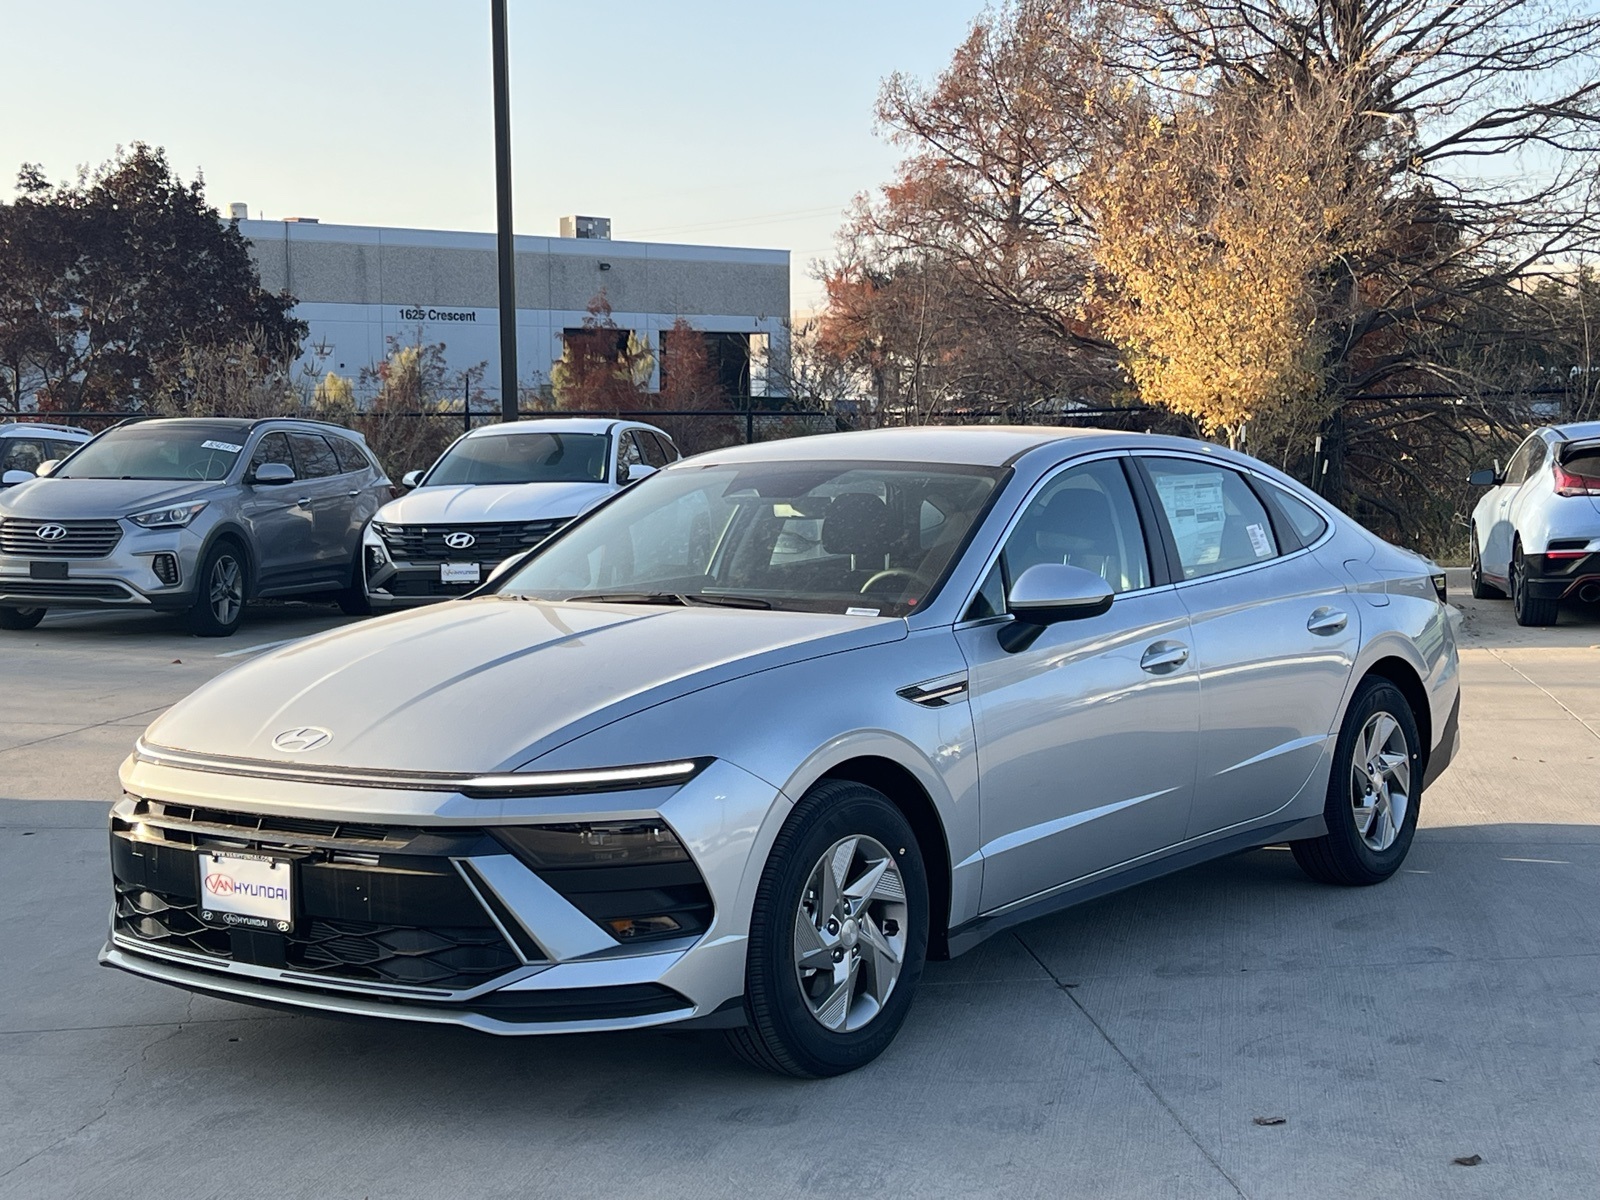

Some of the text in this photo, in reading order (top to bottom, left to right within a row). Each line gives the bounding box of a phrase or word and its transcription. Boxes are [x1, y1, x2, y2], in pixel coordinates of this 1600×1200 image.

[399, 309, 476, 322] 1625 Crescent
[207, 874, 288, 900] VAN HYUNDAI
[238, 917, 268, 927] HYUNDAI
